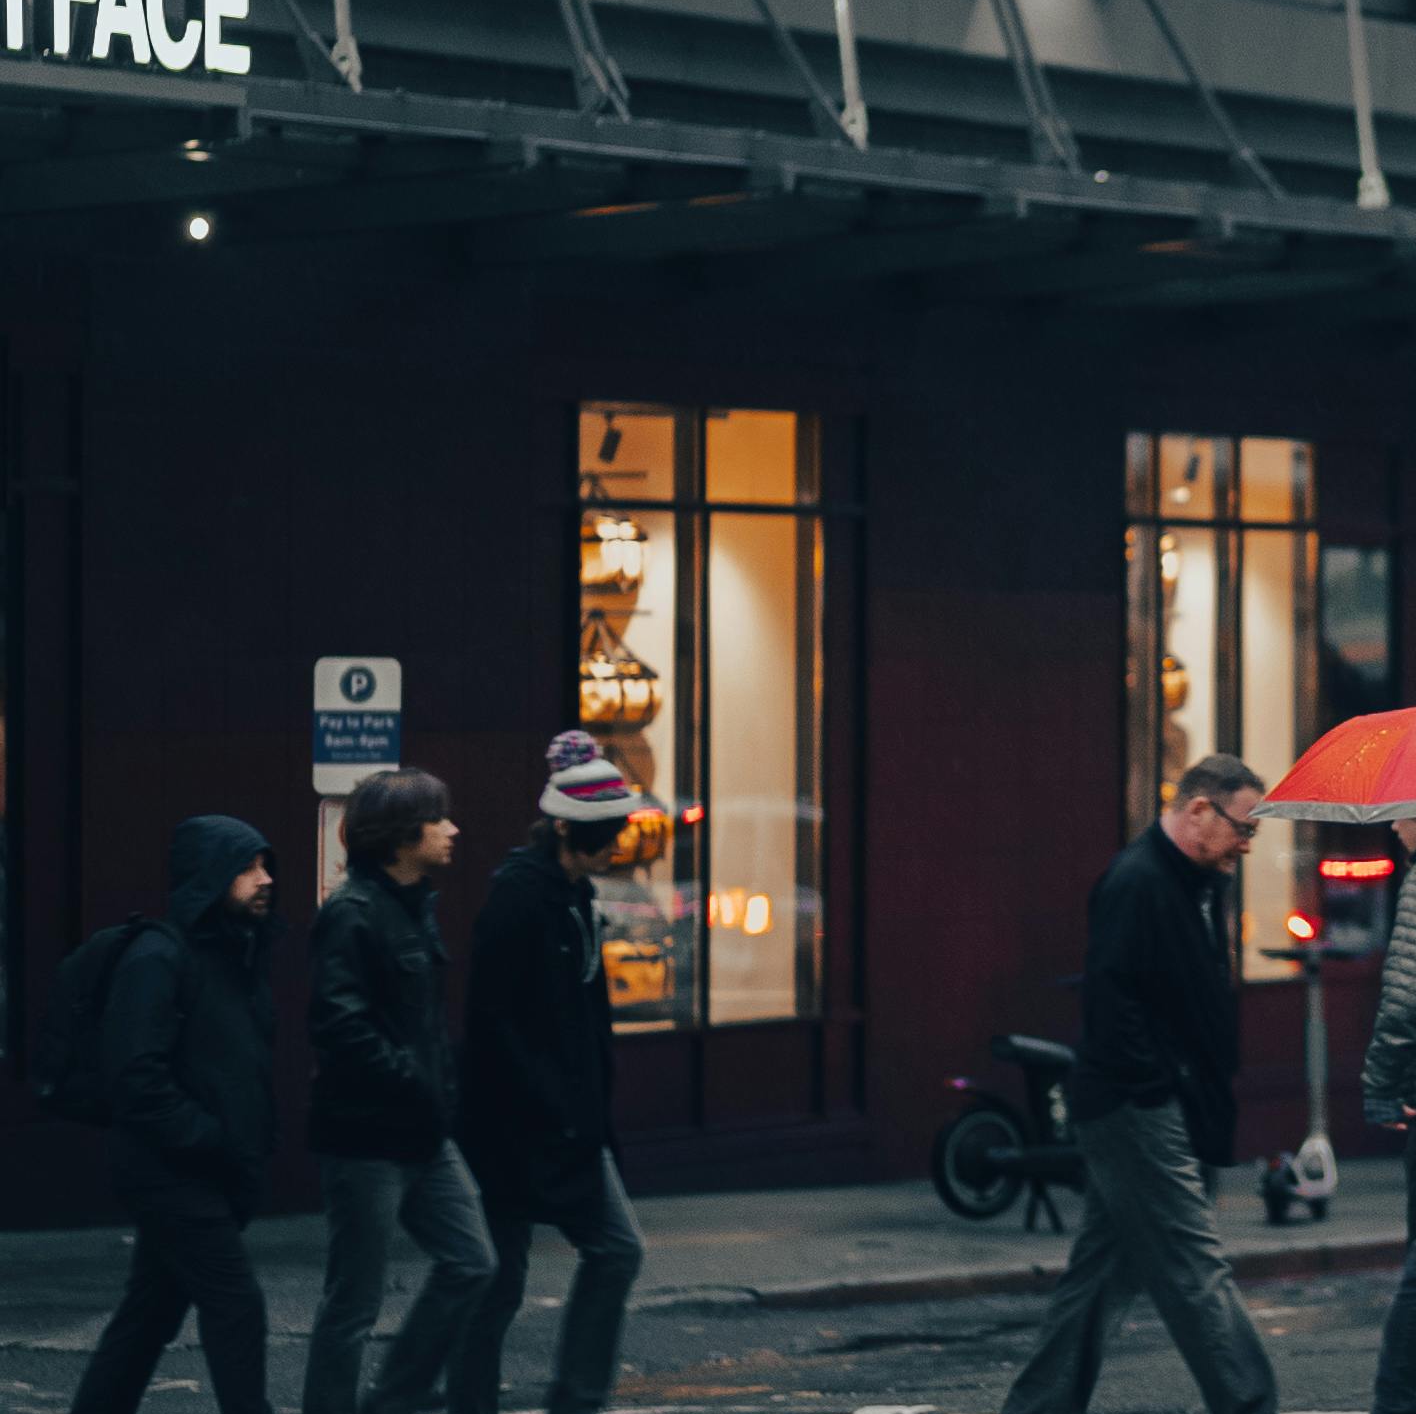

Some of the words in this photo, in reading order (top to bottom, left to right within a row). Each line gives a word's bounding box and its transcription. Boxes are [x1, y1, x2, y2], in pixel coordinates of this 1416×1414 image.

[351, 672, 369, 696] P
[320, 716, 343, 730] Pay
[347, 716, 360, 728] to
[363, 716, 395, 728] Park
